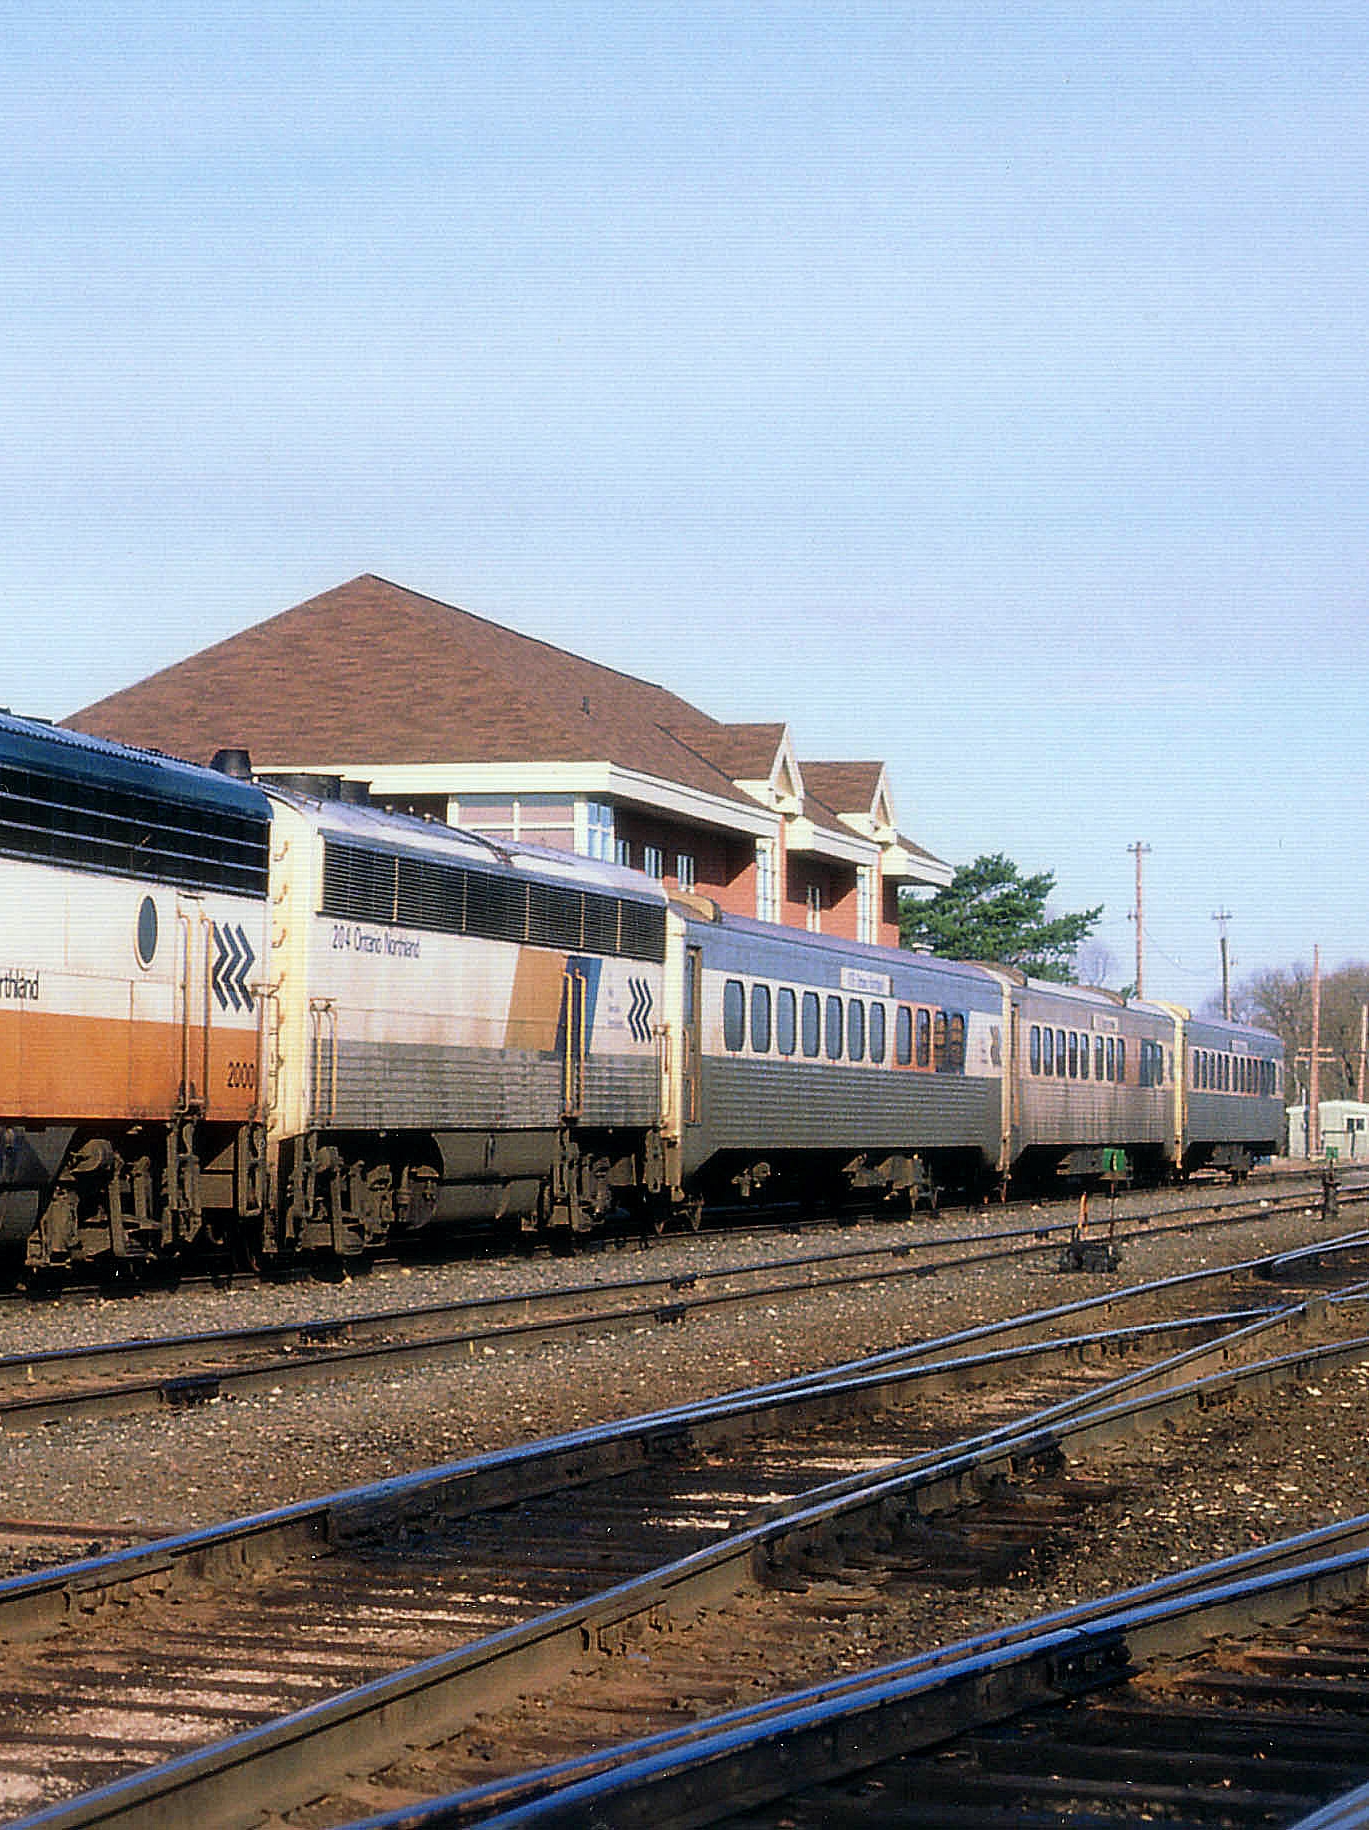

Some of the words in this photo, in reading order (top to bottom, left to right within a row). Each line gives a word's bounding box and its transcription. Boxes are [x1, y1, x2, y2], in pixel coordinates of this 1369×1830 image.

[332, 924, 350, 949] 204
[354, 926, 382, 954] Ontario
[384, 931, 420, 959] Northland
[227, 1061, 254, 1089] 2000
